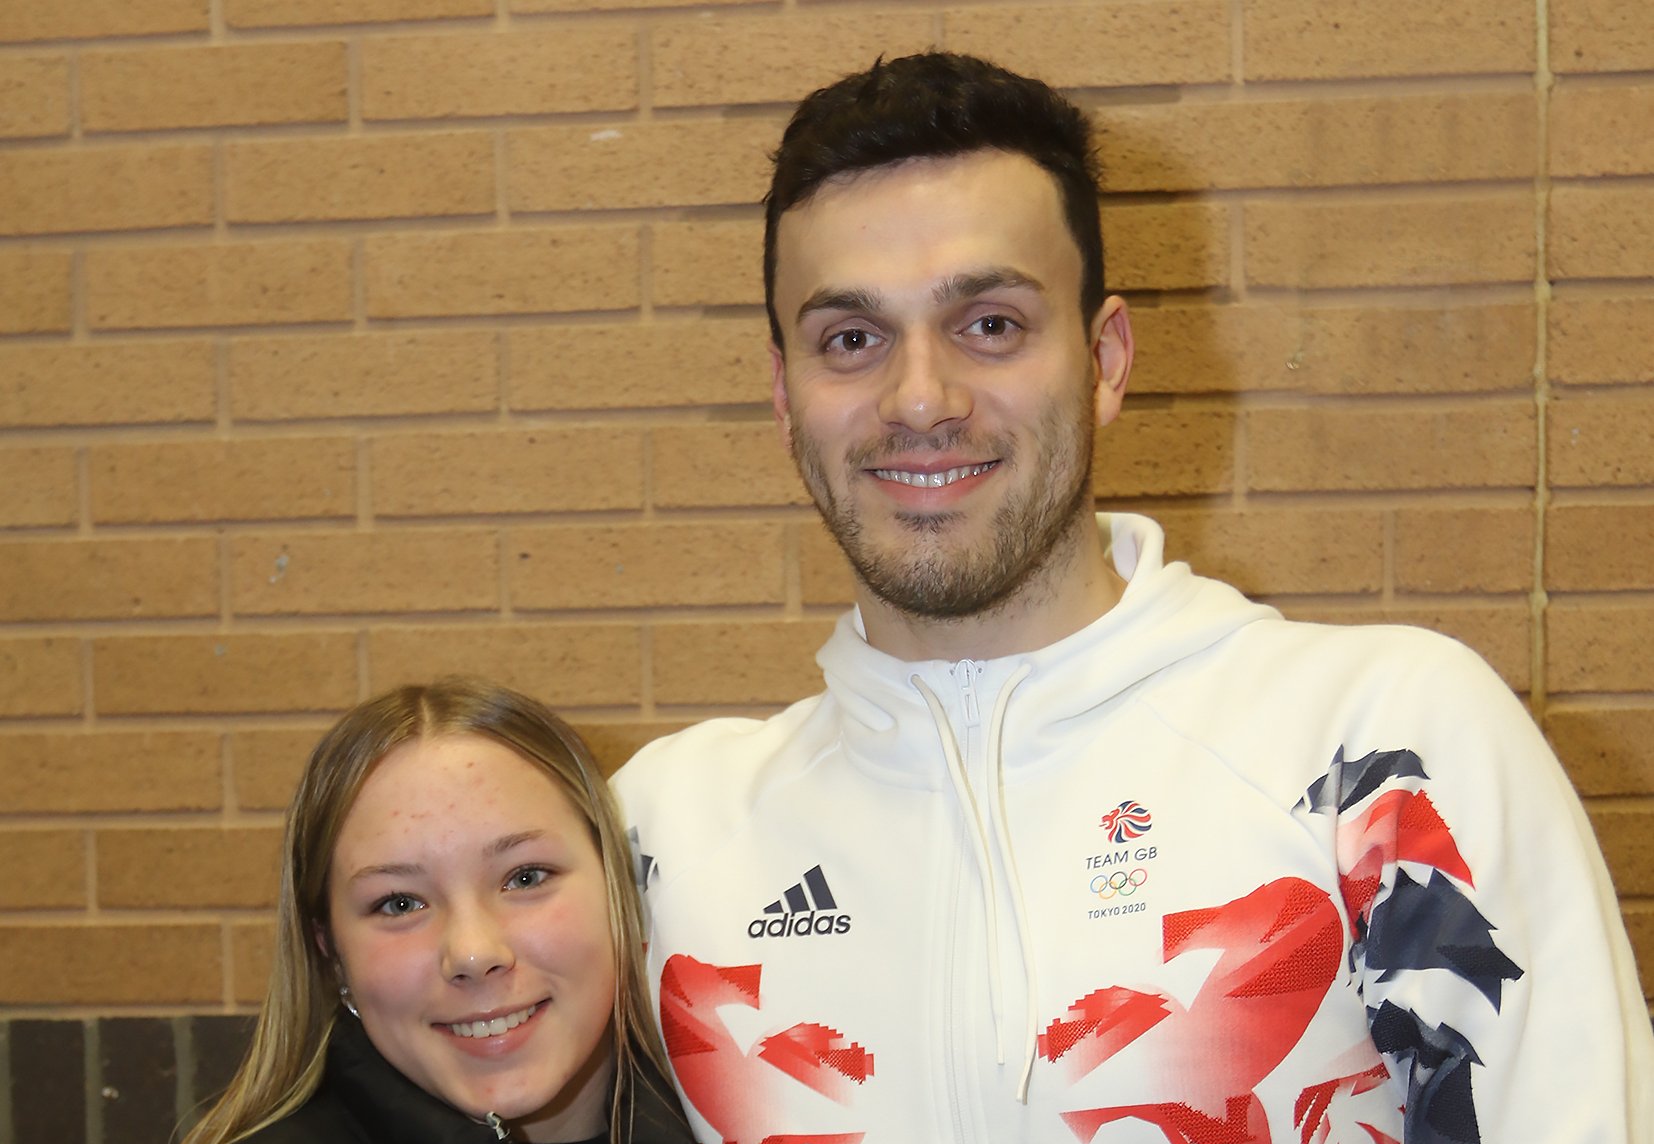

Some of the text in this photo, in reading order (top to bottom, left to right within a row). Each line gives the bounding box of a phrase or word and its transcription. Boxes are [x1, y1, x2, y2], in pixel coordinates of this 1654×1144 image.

[1086, 847, 1158, 869] TEAM GB
[1088, 902, 1146, 919] TOKYO 2020
[748, 910, 851, 938] adidas
